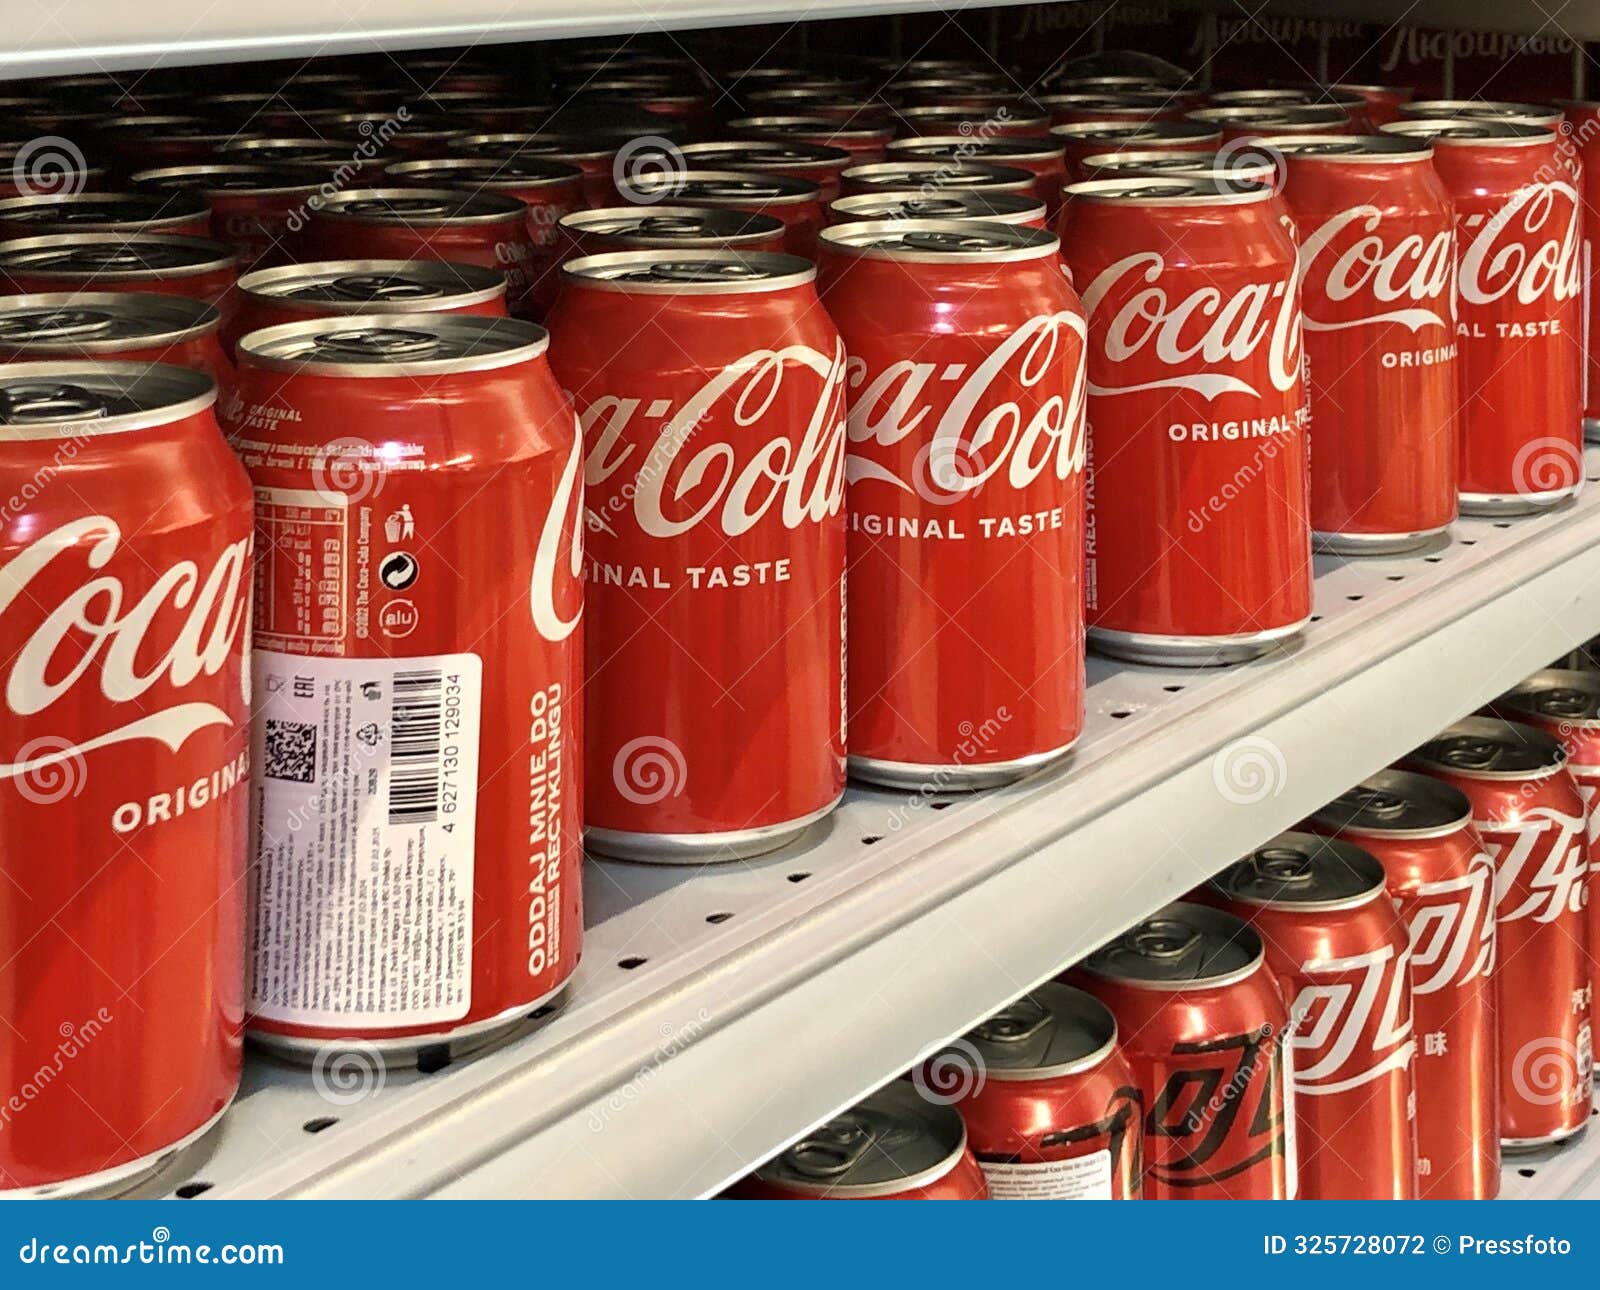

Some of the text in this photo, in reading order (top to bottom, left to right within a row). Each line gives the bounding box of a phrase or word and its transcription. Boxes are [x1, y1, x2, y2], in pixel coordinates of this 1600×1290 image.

[1497, 320, 1560, 338] TASTE
[1168, 414, 1290, 442] ORIGINAL
[358, 506, 372, 544] Company
[853, 508, 1062, 540] IGINAL TASTE
[357, 546, 369, 589] Coca-Cola
[585, 559, 791, 589] INAL TASTE
[357, 591, 369, 605] The
[442, 674, 460, 834] 4 627130 129034
[547, 683, 561, 884] RECYKLINGU
[528, 691, 548, 977] ODDAJ MNIE DO
